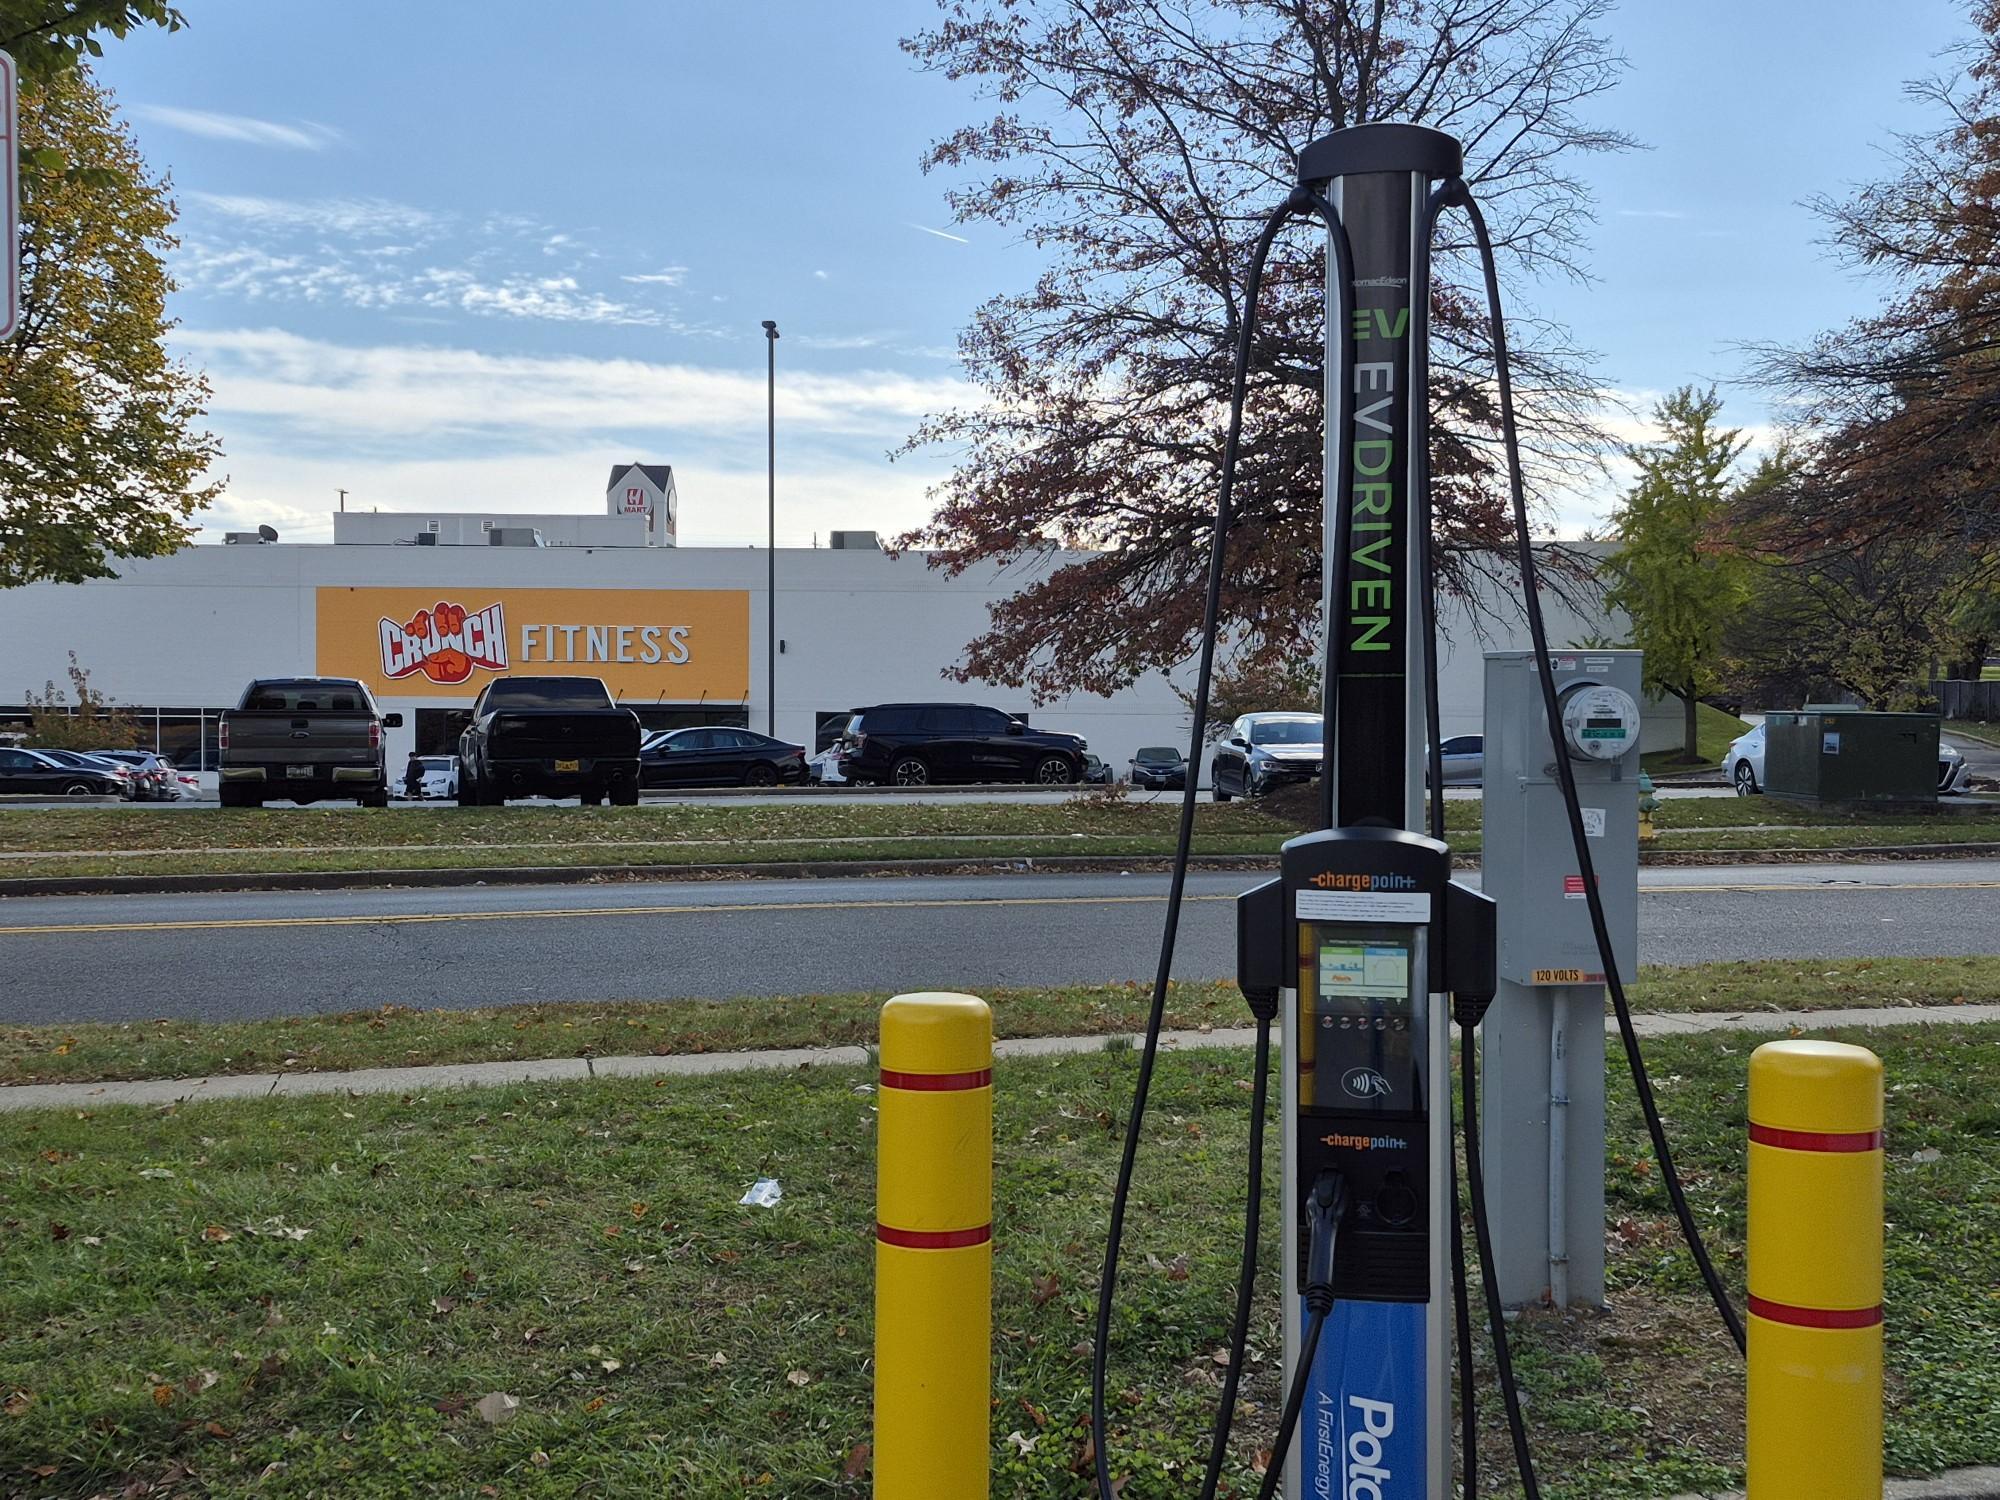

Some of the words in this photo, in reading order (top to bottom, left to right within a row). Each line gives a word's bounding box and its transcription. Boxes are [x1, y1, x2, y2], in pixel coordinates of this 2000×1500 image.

[628, 489, 643, 505] H
[1351, 362, 1393, 651] EVDRIVEN
[380, 603, 507, 676] CRUNCH
[522, 624, 689, 664] FITNESS
[1536, 970, 1551, 981] 120
[1553, 969, 1579, 981] VOLTS
[1317, 1391, 1333, 1405] A
